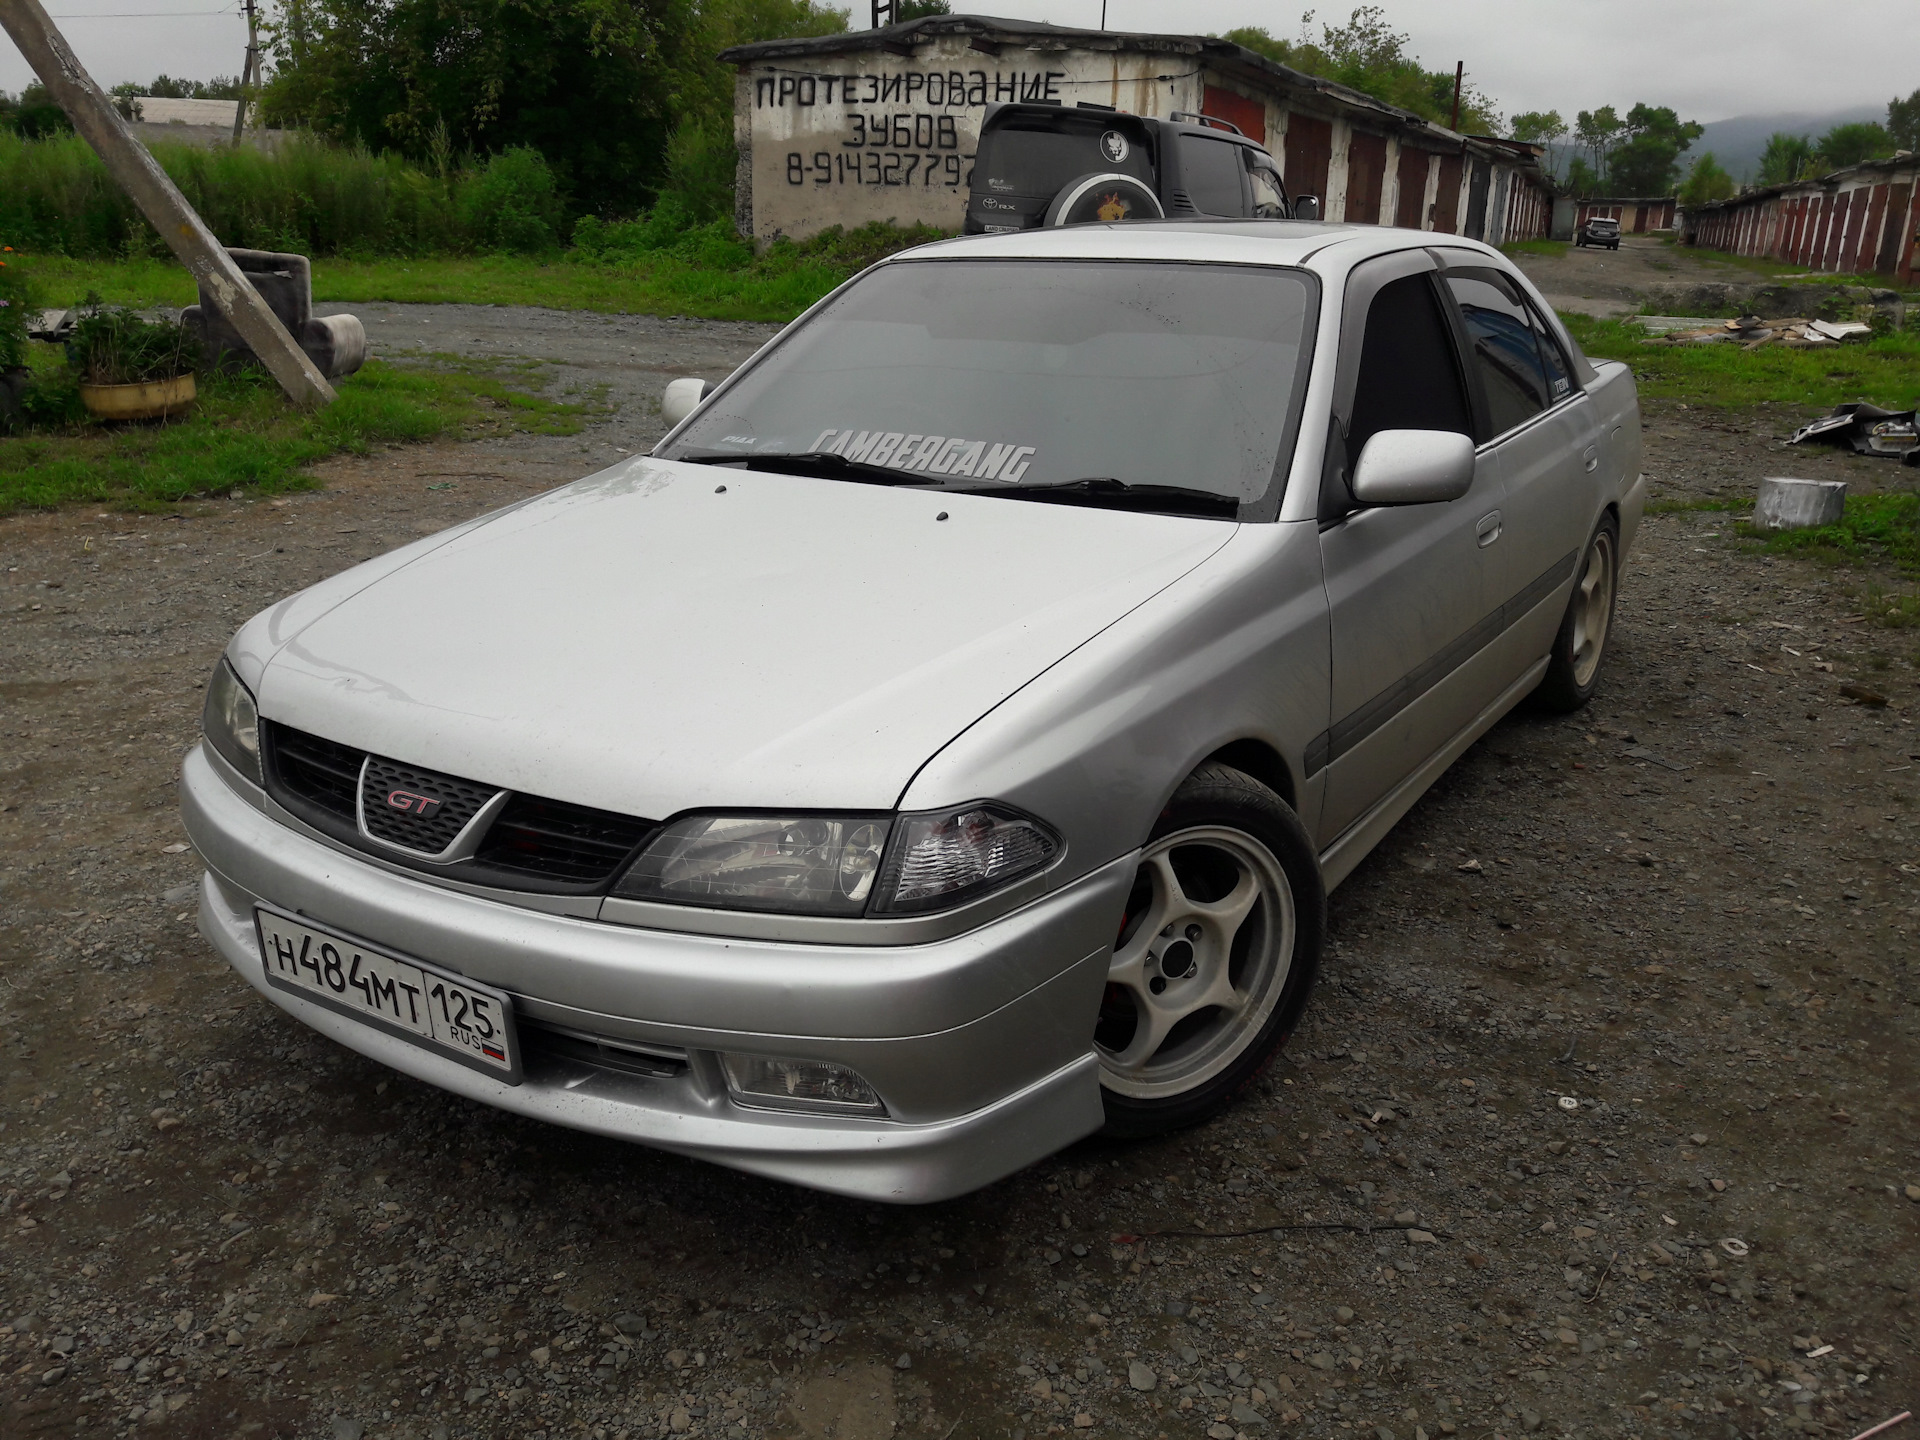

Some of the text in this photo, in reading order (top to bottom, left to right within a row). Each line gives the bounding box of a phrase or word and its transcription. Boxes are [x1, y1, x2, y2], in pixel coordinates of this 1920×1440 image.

[842, 114, 958, 150] ЗУБОВ
[721, 435, 757, 445] PIAA
[387, 790, 441, 814] GT
[431, 982, 494, 1039] 125
[450, 1025, 481, 1051] RUS
